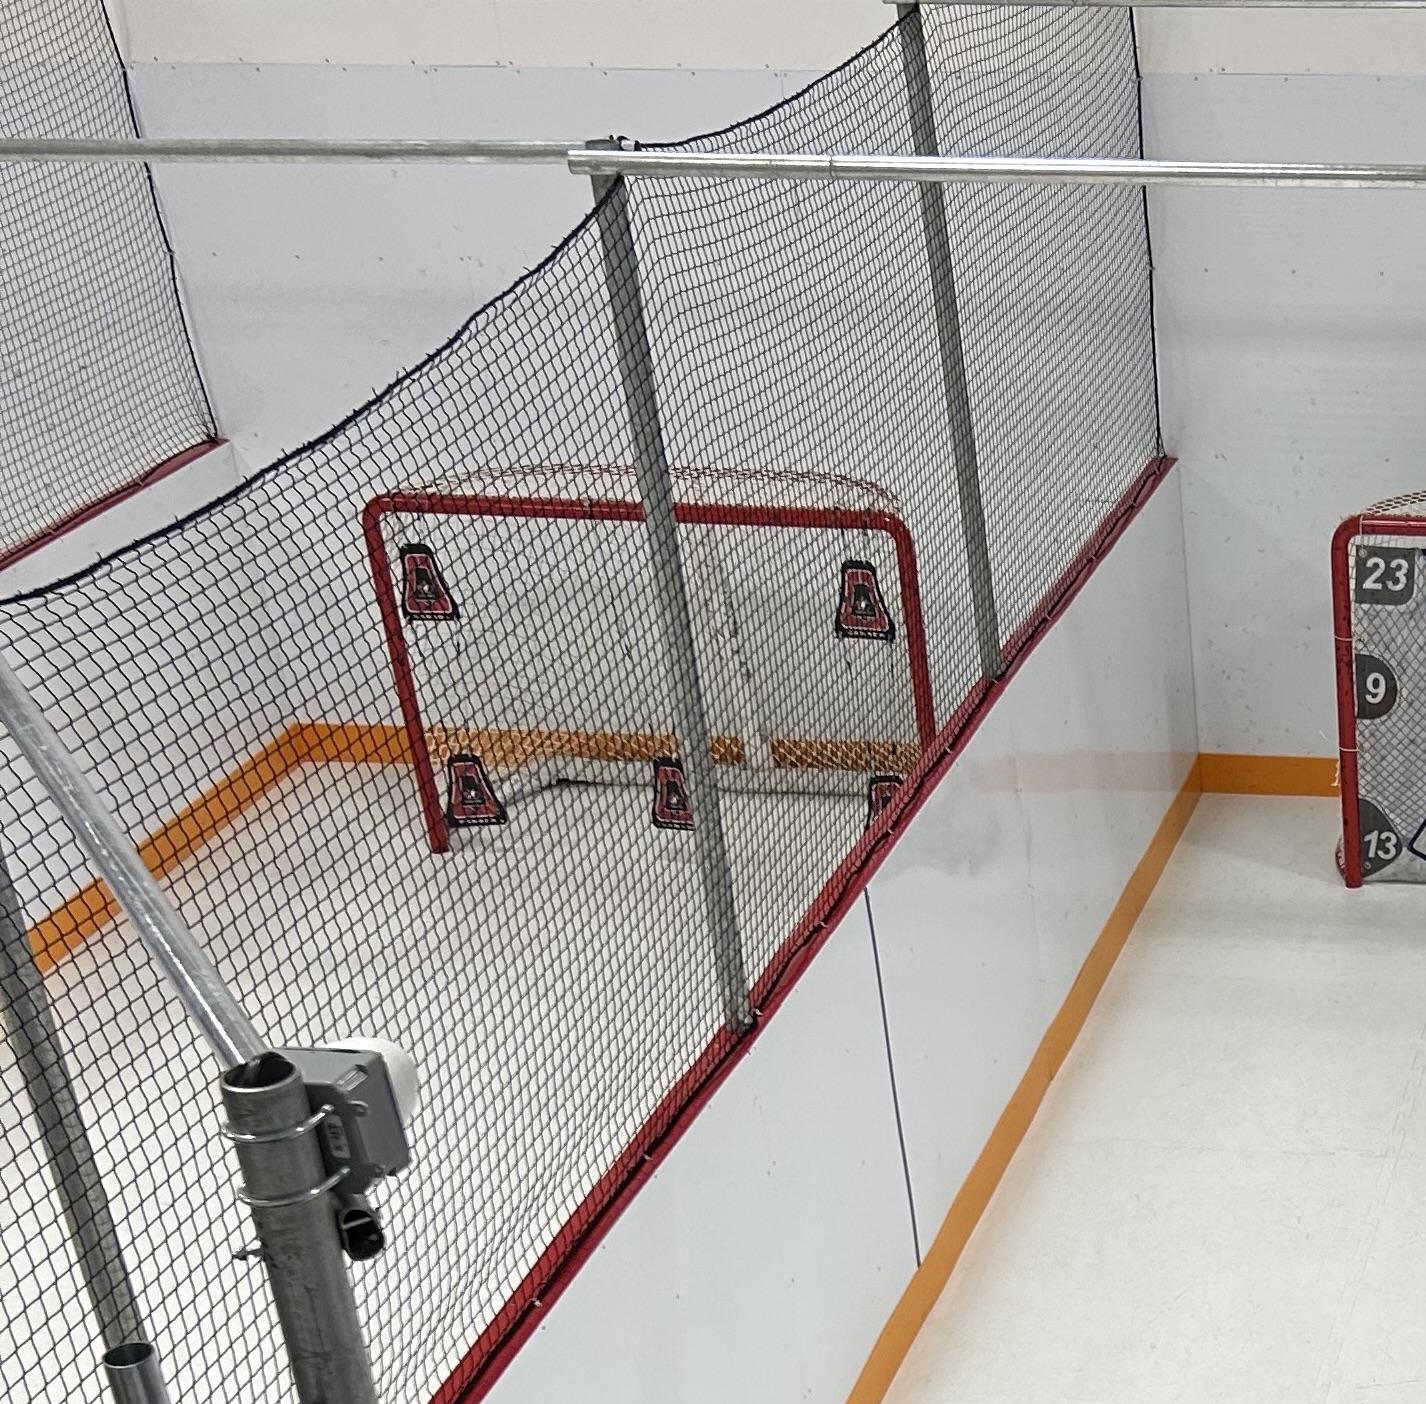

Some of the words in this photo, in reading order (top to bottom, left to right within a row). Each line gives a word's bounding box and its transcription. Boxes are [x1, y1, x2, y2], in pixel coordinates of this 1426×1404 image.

[1362, 557, 1409, 591] 23
[1365, 672, 1386, 704] 9
[1363, 830, 1398, 860] 13
